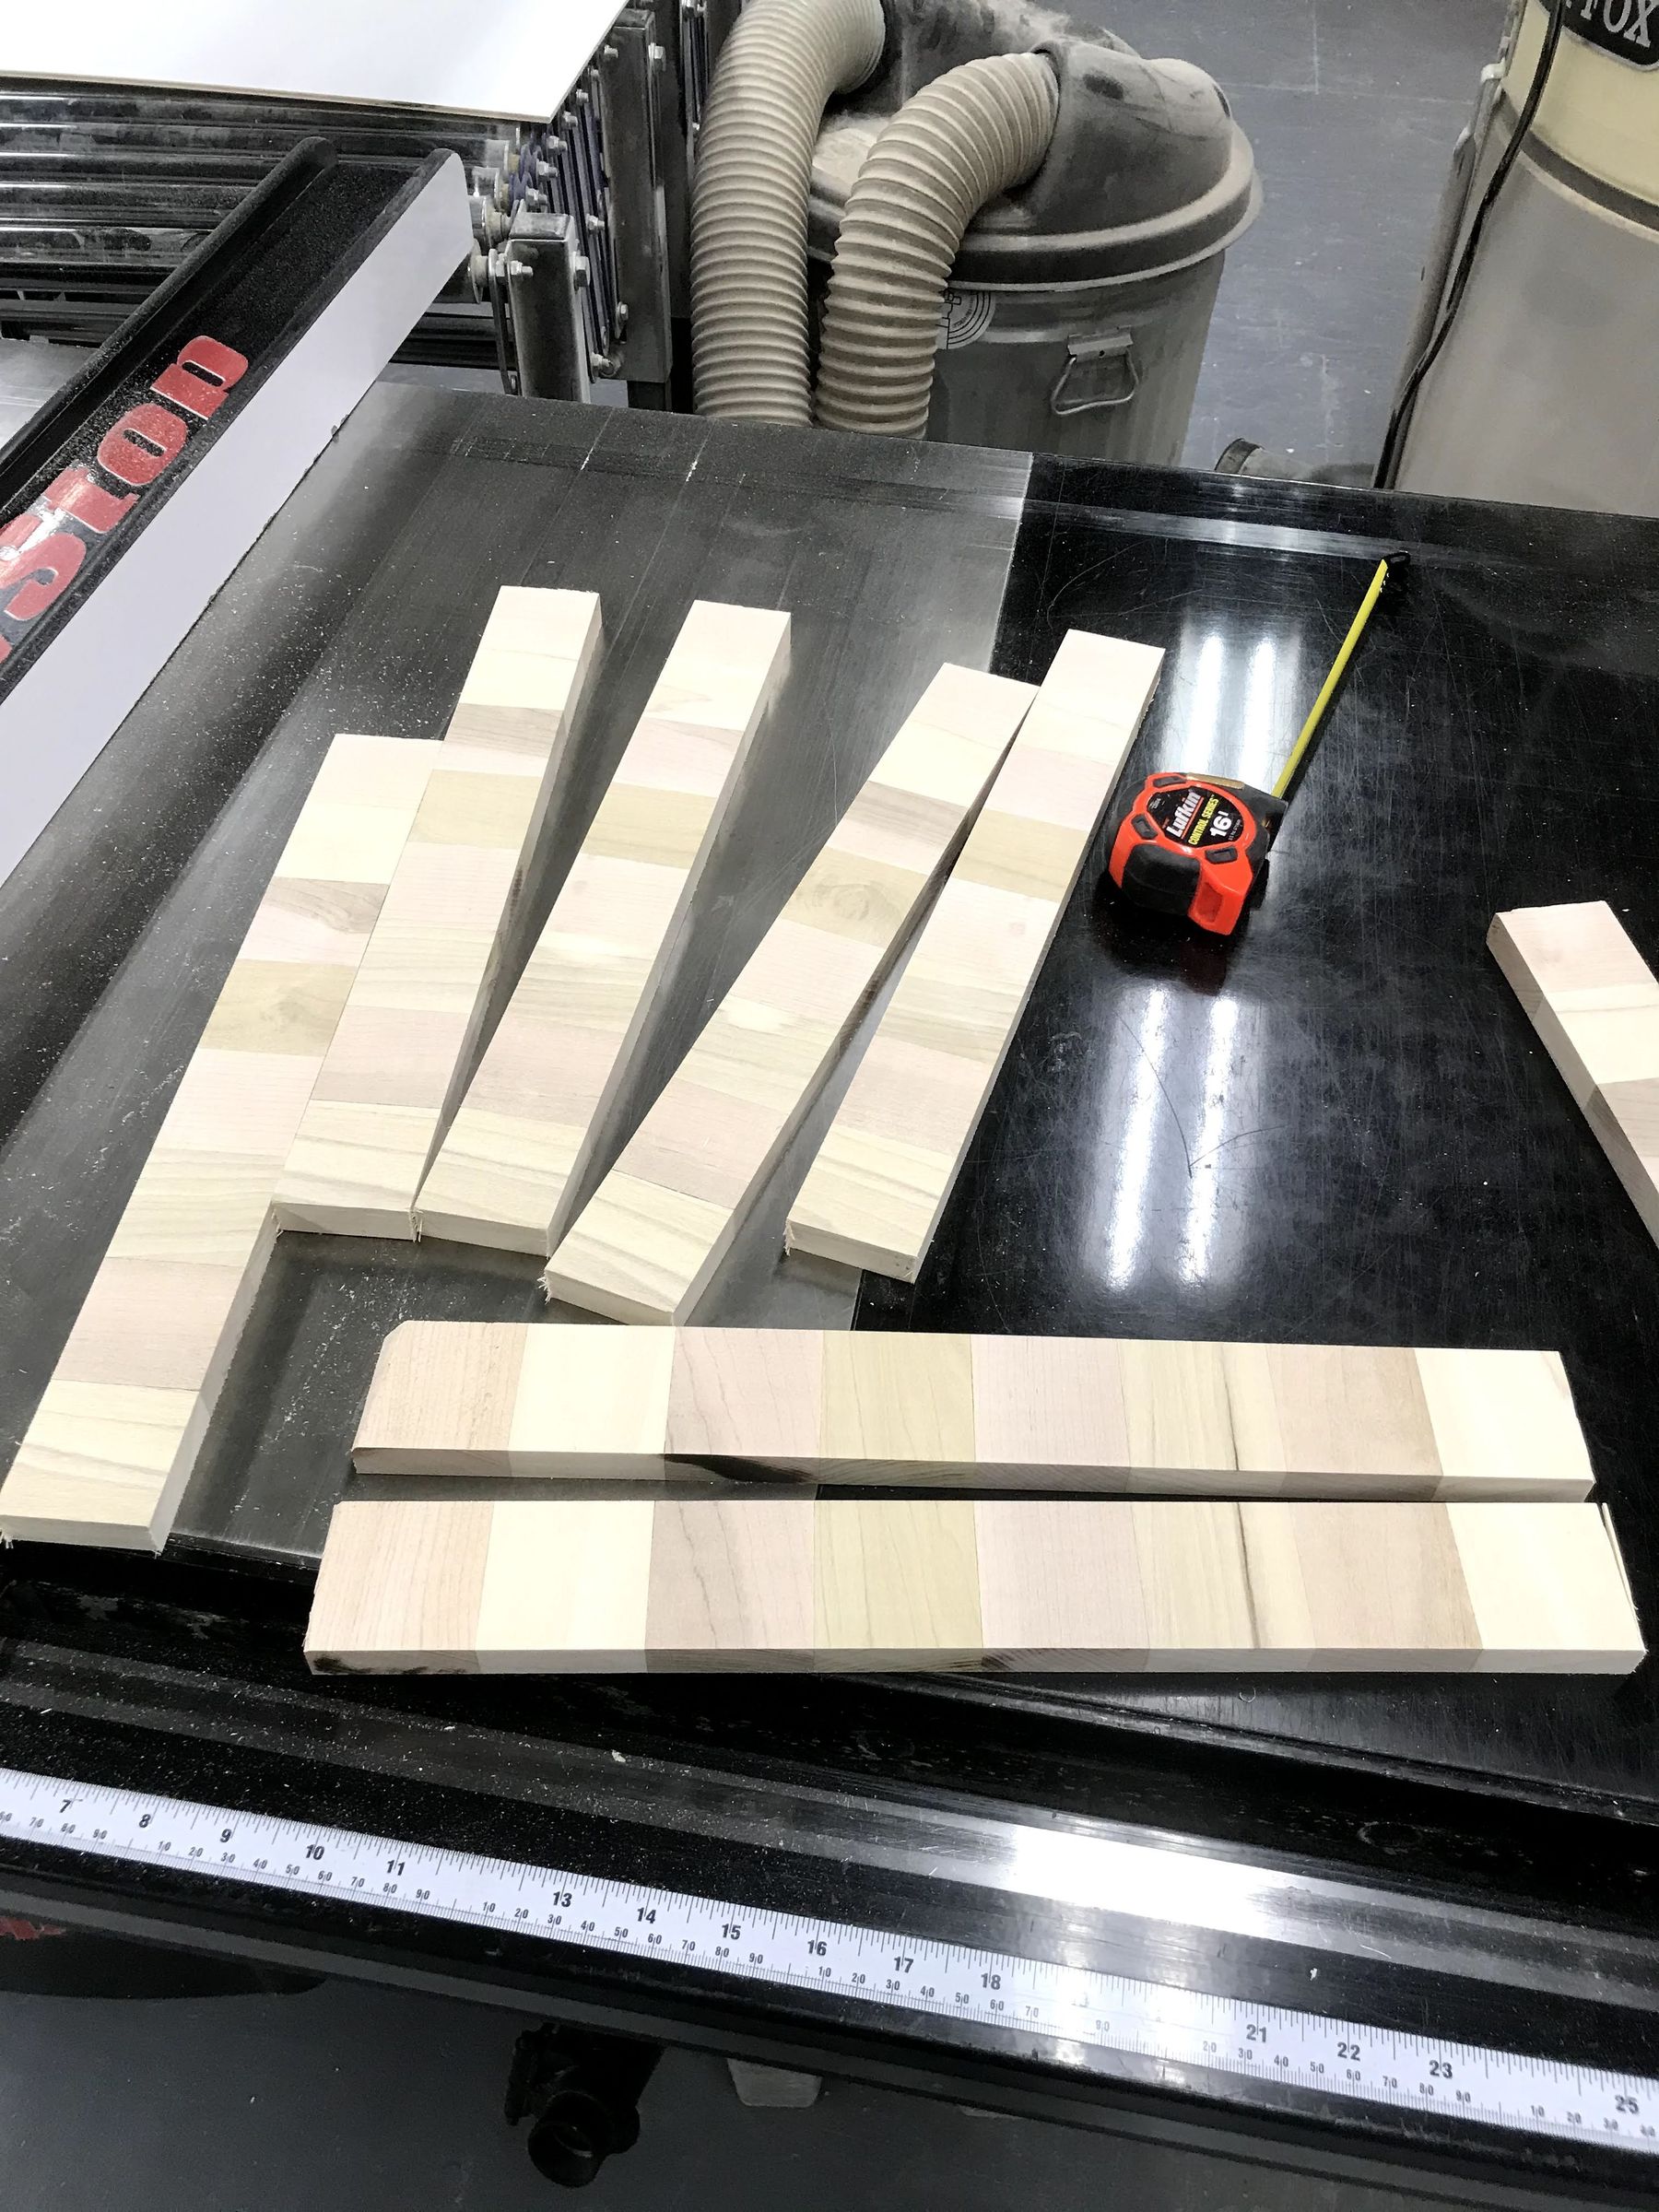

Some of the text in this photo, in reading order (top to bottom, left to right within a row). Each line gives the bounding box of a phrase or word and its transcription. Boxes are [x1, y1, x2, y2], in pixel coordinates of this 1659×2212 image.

[0, 335, 248, 665] Stop
[1166, 792, 1202, 837] Lufkin
[1188, 818, 1209, 845] CONTROL
[29, 1817, 44, 1828] 70
[61, 1823, 76, 1834] 80
[93, 1829, 108, 1840] 90
[159, 1841, 171, 1852] 10
[189, 1847, 204, 1857] 20
[221, 1853, 236, 1864] 30
[253, 1858, 268, 1869] 40
[286, 1865, 300, 1876] 50
[318, 1870, 333, 1881] 60
[351, 1877, 365, 1888] 70
[382, 1883, 397, 1894] 80
[416, 1889, 430, 1900] 90
[482, 1901, 496, 1912] 10
[514, 1908, 529, 1919] 20
[547, 1913, 561, 1925] 30
[581, 1920, 595, 1932] 40
[614, 1926, 629, 1937] 50
[647, 1933, 662, 1945] 60
[682, 1939, 696, 1951] 70
[715, 1946, 729, 1958] 80
[748, 1952, 763, 1964] 90
[818, 1966, 831, 1977] 10
[852, 1972, 865, 1984] 20
[886, 1979, 900, 1991] 30
[920, 1985, 935, 1997] 40
[955, 1992, 970, 2004] 50
[990, 1999, 1005, 2011] 60
[1025, 2005, 1040, 2018] 70
[1203, 2041, 1217, 2053] 20
[1238, 2047, 1253, 2061] 30
[1274, 2054, 1288, 2067] 40
[1310, 2061, 1324, 2074] 50
[1346, 2068, 1361, 2081] 60
[1382, 2076, 1397, 2088] 70
[1418, 2083, 1434, 2096] 80
[1455, 2089, 1471, 2102] 90
[60, 1799, 1640, 2114] 7 8 9 10 11 13 14 15 16 17 18 21 22 23 25
